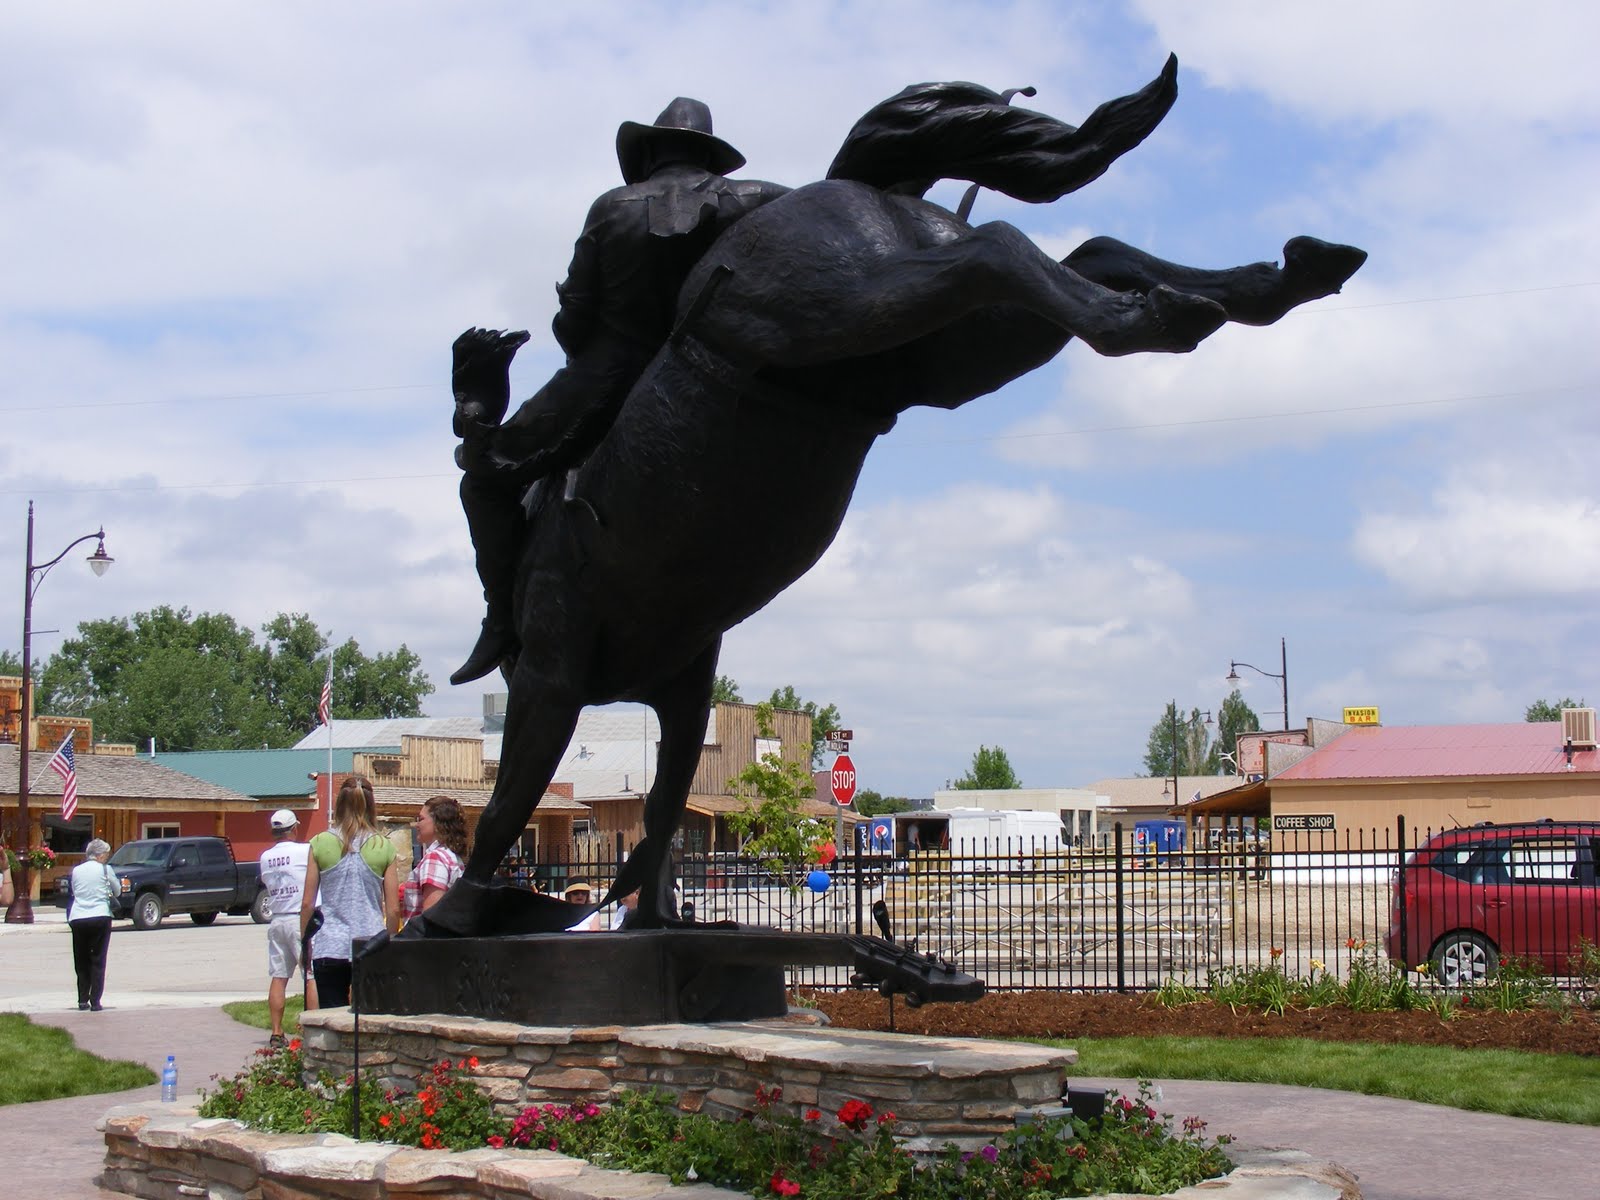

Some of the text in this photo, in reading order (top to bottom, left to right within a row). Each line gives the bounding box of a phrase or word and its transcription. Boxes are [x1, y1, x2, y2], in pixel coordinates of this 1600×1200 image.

[831, 731, 841, 740] 1ST
[833, 771, 854, 789] STOP
[1276, 816, 1333, 828] COFFEE SHOP
[268, 856, 290, 868] RODEO
